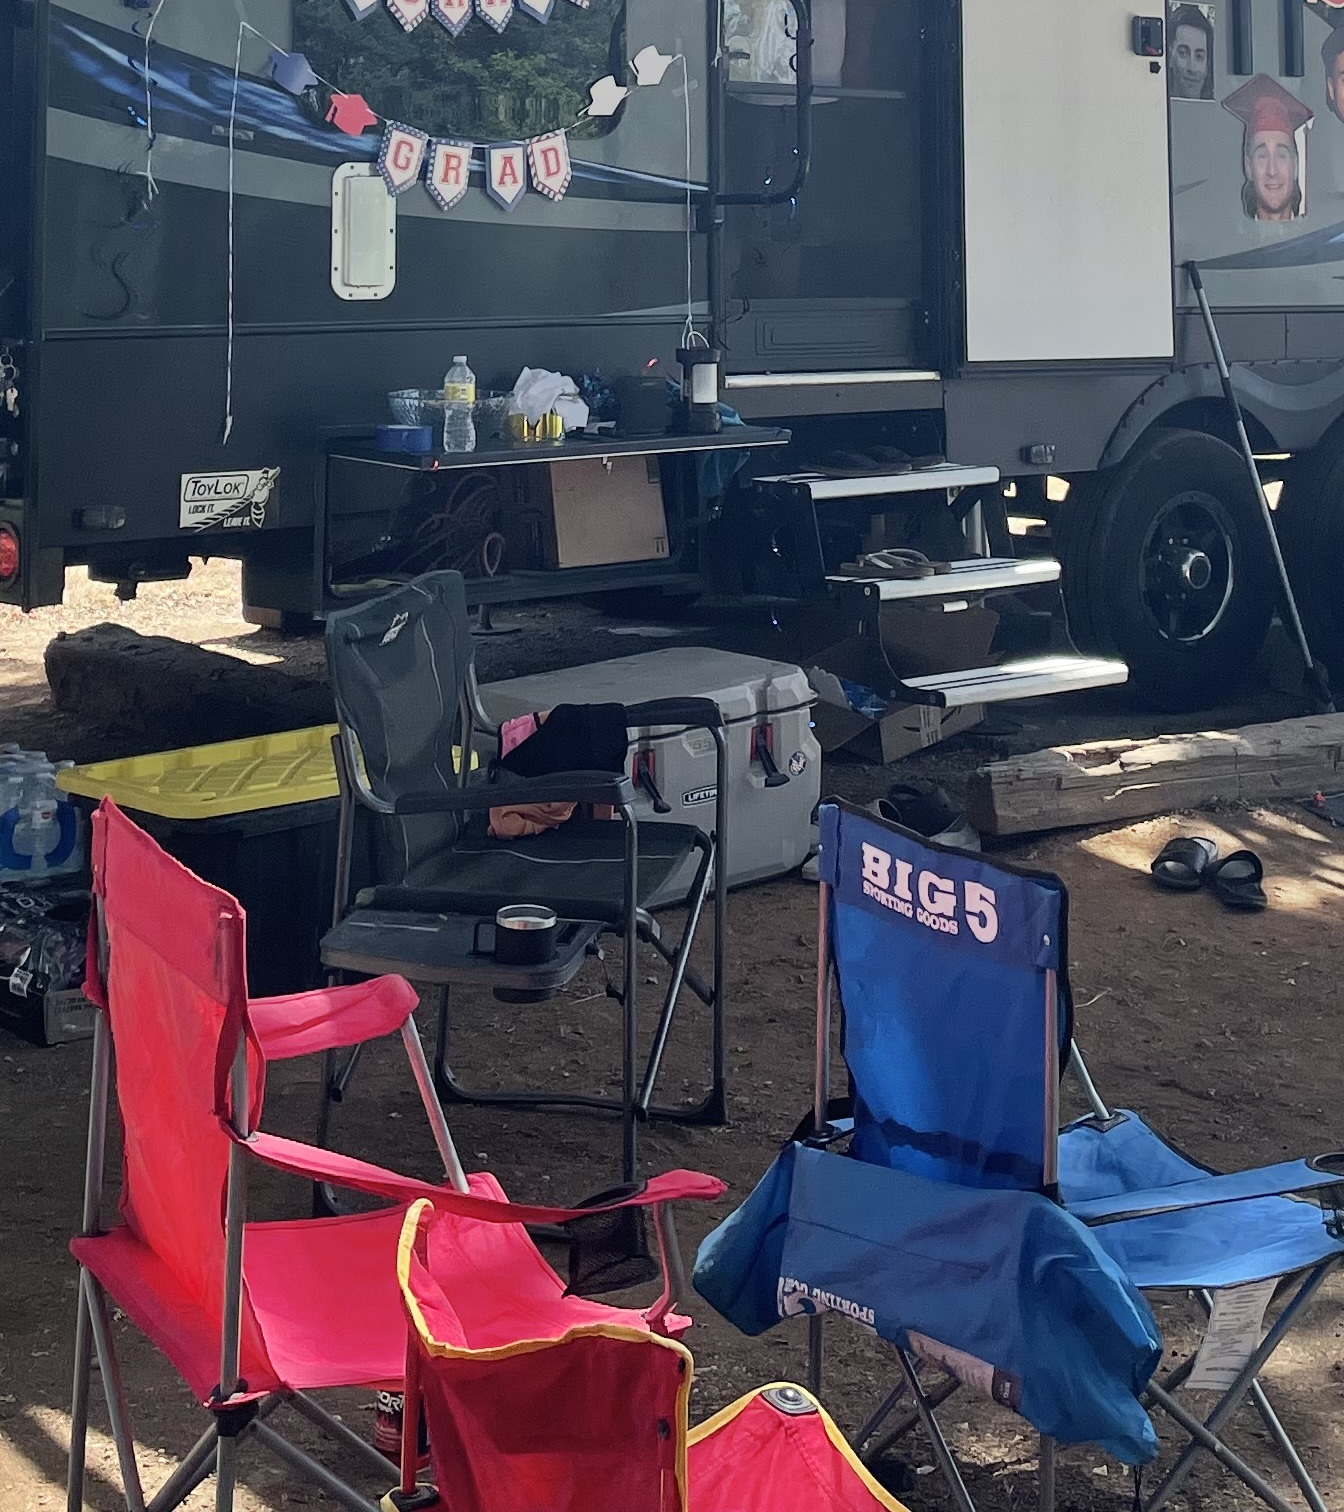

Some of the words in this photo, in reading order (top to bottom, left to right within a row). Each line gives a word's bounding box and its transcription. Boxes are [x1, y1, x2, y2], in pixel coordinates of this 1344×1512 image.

[392, 139, 562, 186] GRAD
[861, 841, 957, 918] BIG
[964, 880, 999, 944] 5
[863, 880, 913, 919] SPORTING
[916, 907, 959, 936] GOODS
